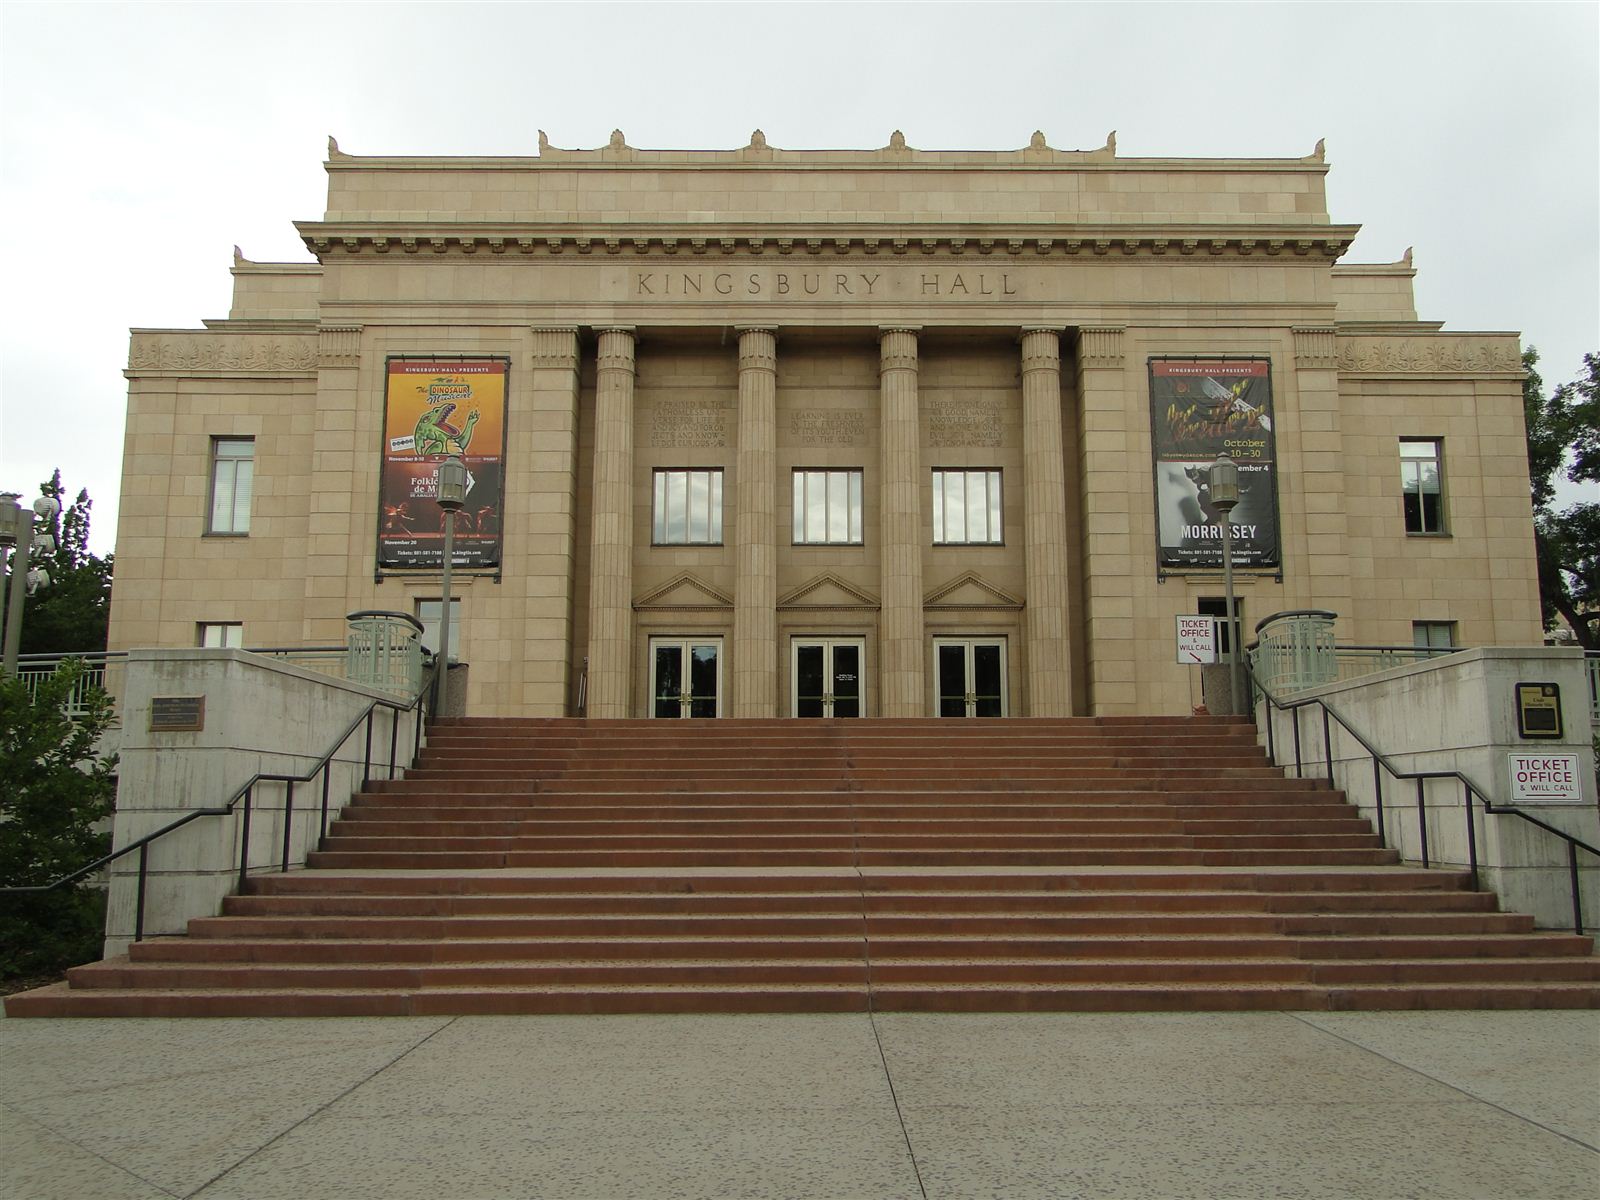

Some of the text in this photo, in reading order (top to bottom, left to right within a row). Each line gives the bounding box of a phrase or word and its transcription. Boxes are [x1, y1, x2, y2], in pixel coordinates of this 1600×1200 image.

[636, 273, 1017, 295] KINGSBURY HALL
[416, 386, 429, 394] The
[431, 385, 468, 395] DINOSAUR
[1223, 439, 1266, 447] October
[414, 485, 425, 493] de
[1181, 525, 1257, 539] MORRISEY
[1180, 620, 1209, 628] TICKET
[1180, 629, 1210, 637] OFFICE
[1516, 759, 1570, 770] TICKET
[1517, 772, 1573, 783] OFFICE
